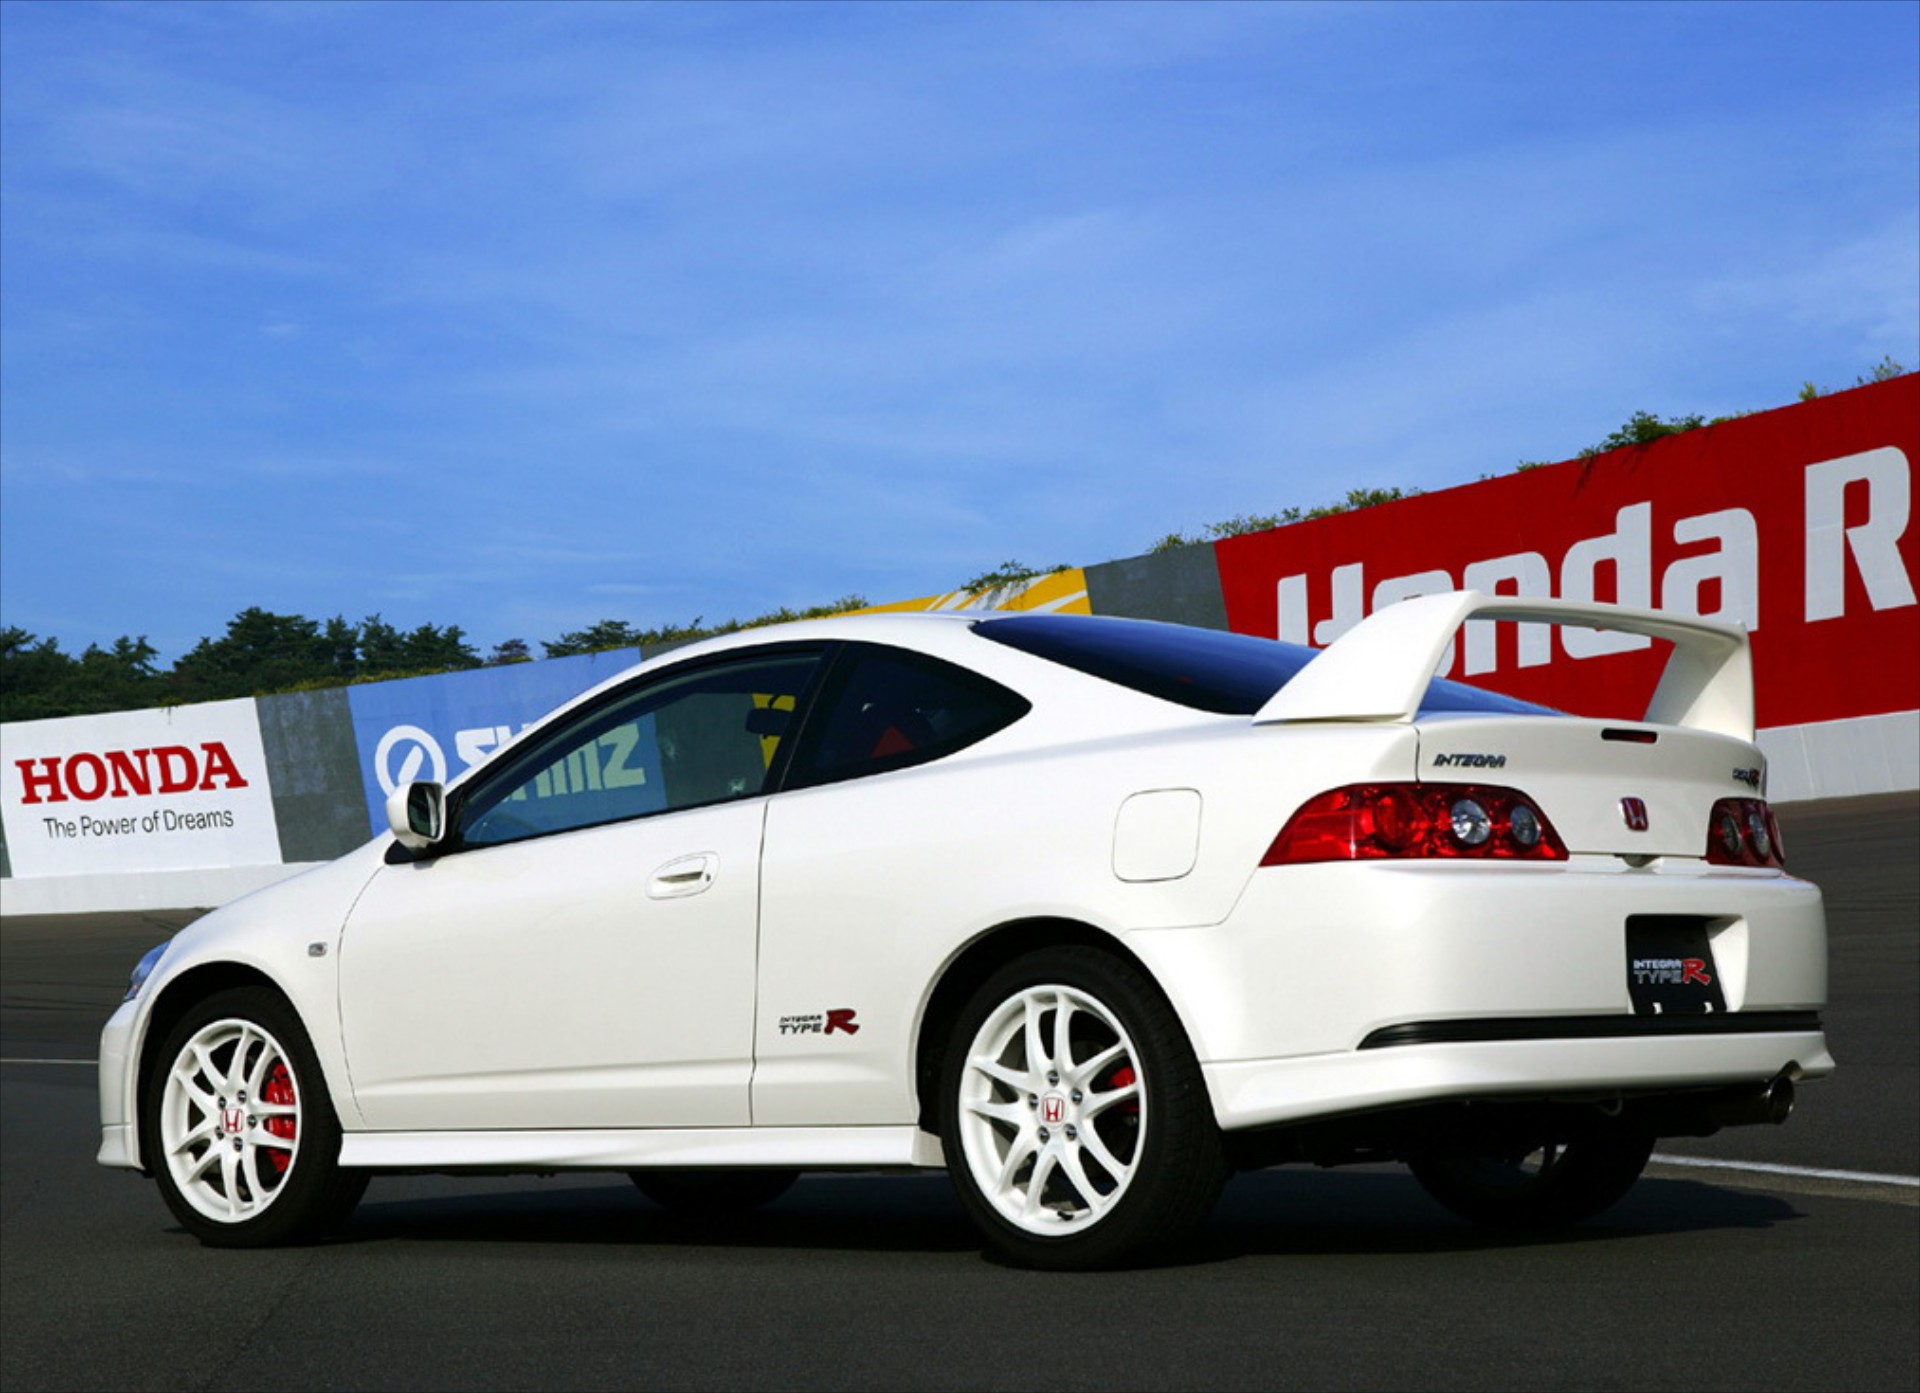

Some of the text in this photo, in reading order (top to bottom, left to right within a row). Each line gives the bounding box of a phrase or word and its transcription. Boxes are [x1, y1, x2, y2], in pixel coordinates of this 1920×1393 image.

[15, 741, 248, 804] HONDA
[43, 809, 234, 838] The Power of Dreams
[1633, 959, 1682, 969] INTEGRA
[1633, 958, 1711, 985] TYPE R
[779, 1008, 860, 1035] TYPE R
